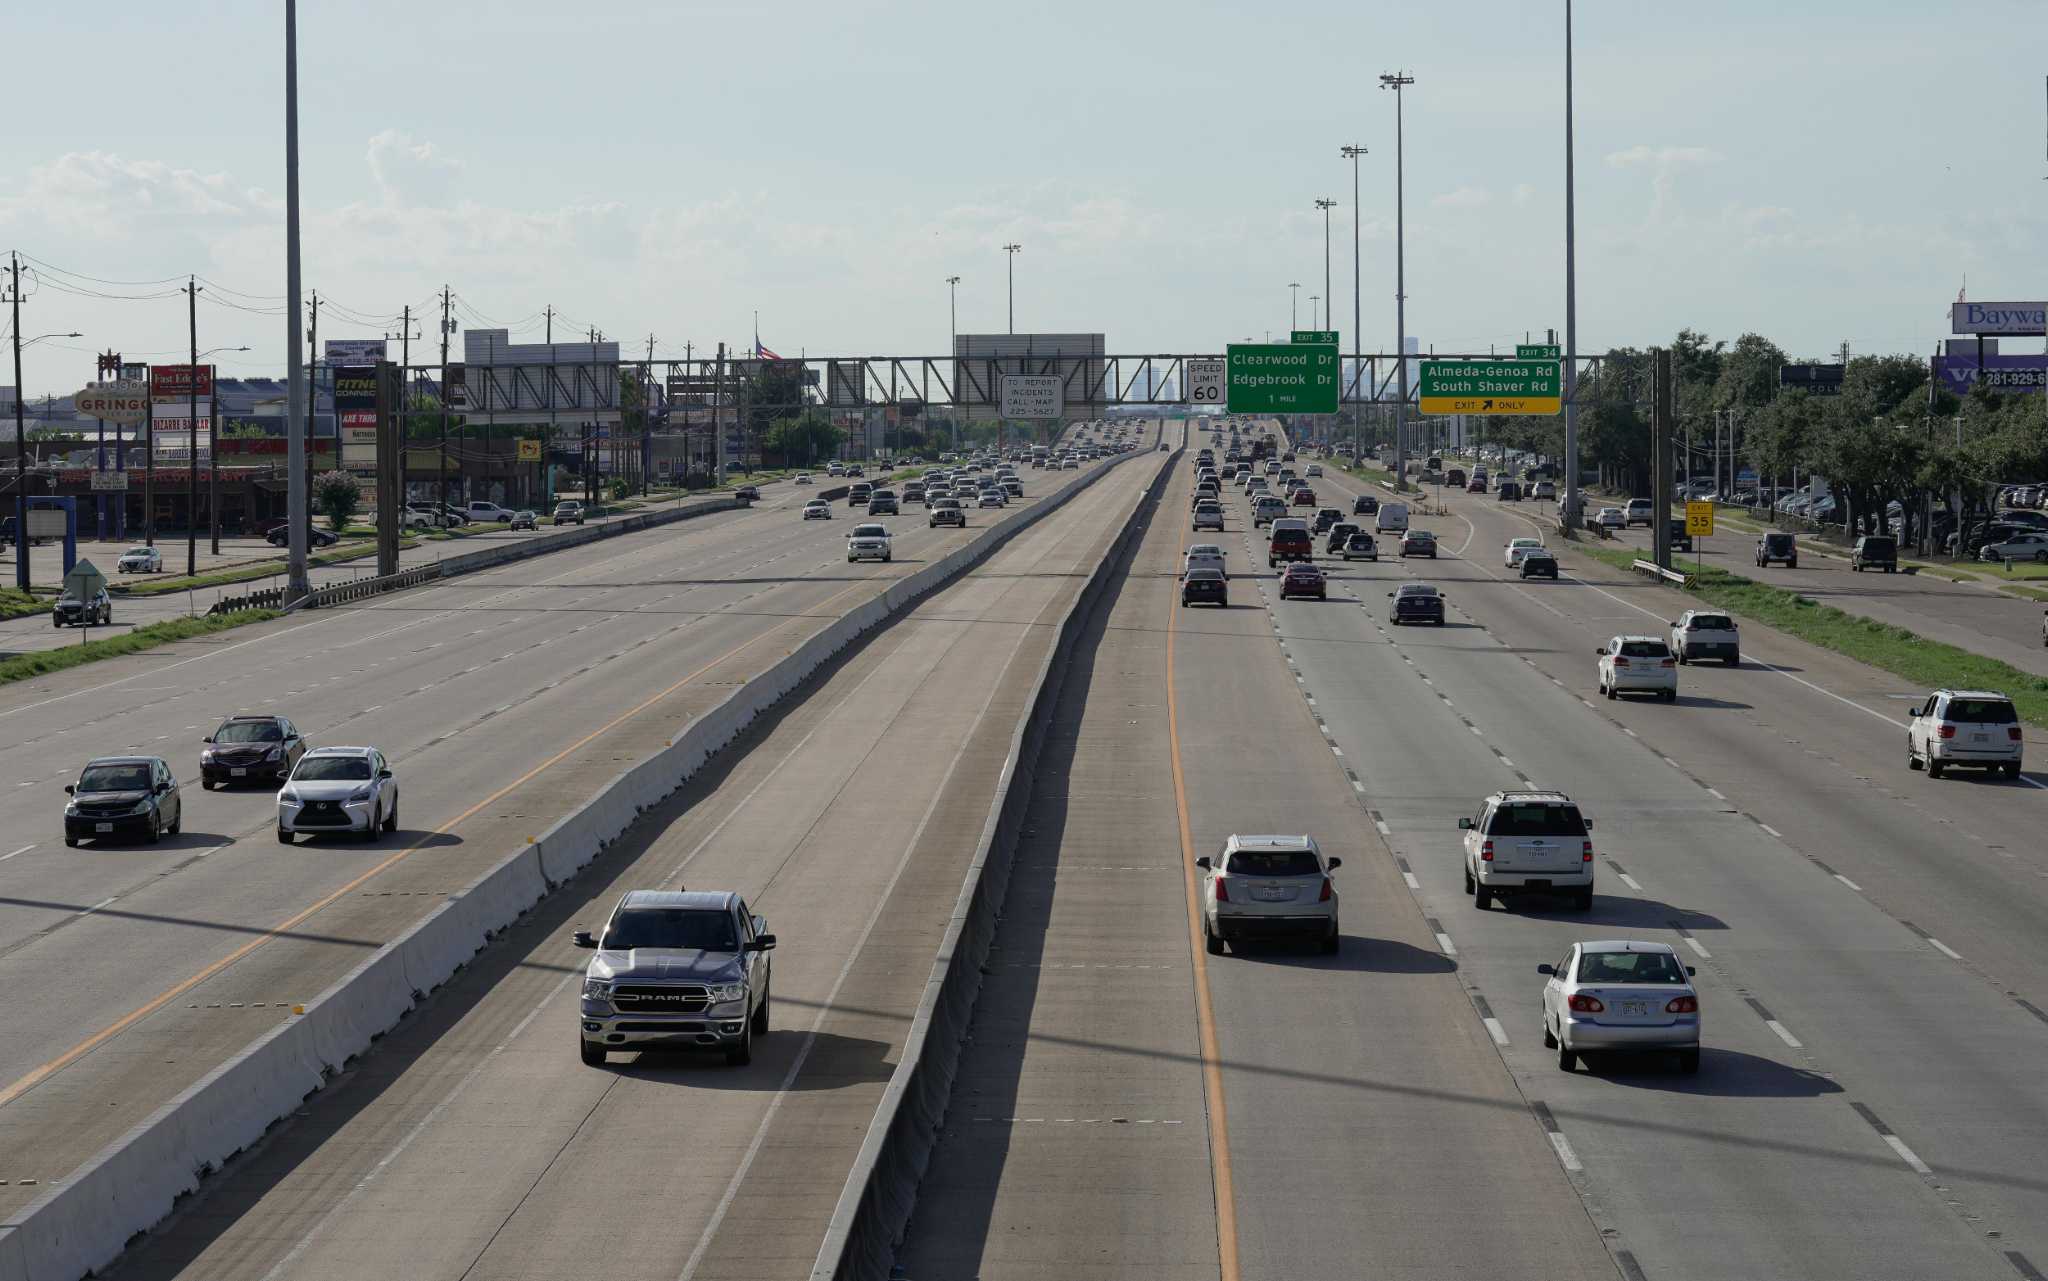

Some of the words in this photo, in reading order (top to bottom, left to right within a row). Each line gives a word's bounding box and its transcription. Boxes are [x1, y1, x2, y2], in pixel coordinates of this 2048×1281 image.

[1320, 333, 1333, 342] 35
[1543, 347, 1556, 357] 34
[1232, 354, 1307, 365] Clearwood
[1318, 354, 1333, 365] Dr
[1190, 364, 1222, 373] SPEED
[1428, 366, 1529, 377] Almeda-Genoa
[1536, 366, 1553, 376] Rd
[175, 373, 208, 384] Edde's
[1193, 375, 1219, 383] LIMIT
[1233, 374, 1306, 387] Edgebrook
[1317, 374, 1332, 385] Dr
[1432, 381, 1472, 391] South
[1478, 381, 1525, 391] Shaver
[1531, 381, 1549, 391] Rd
[1194, 386, 1218, 400] 60
[1007, 398, 1028, 406] CALL
[1269, 395, 1274, 404] 1
[1455, 401, 1476, 410] EXIT
[1498, 401, 1525, 410] ONLY
[153, 419, 181, 431] BIZARRE
[182, 418, 209, 430] BAAAR
[1690, 516, 1710, 527] 35
